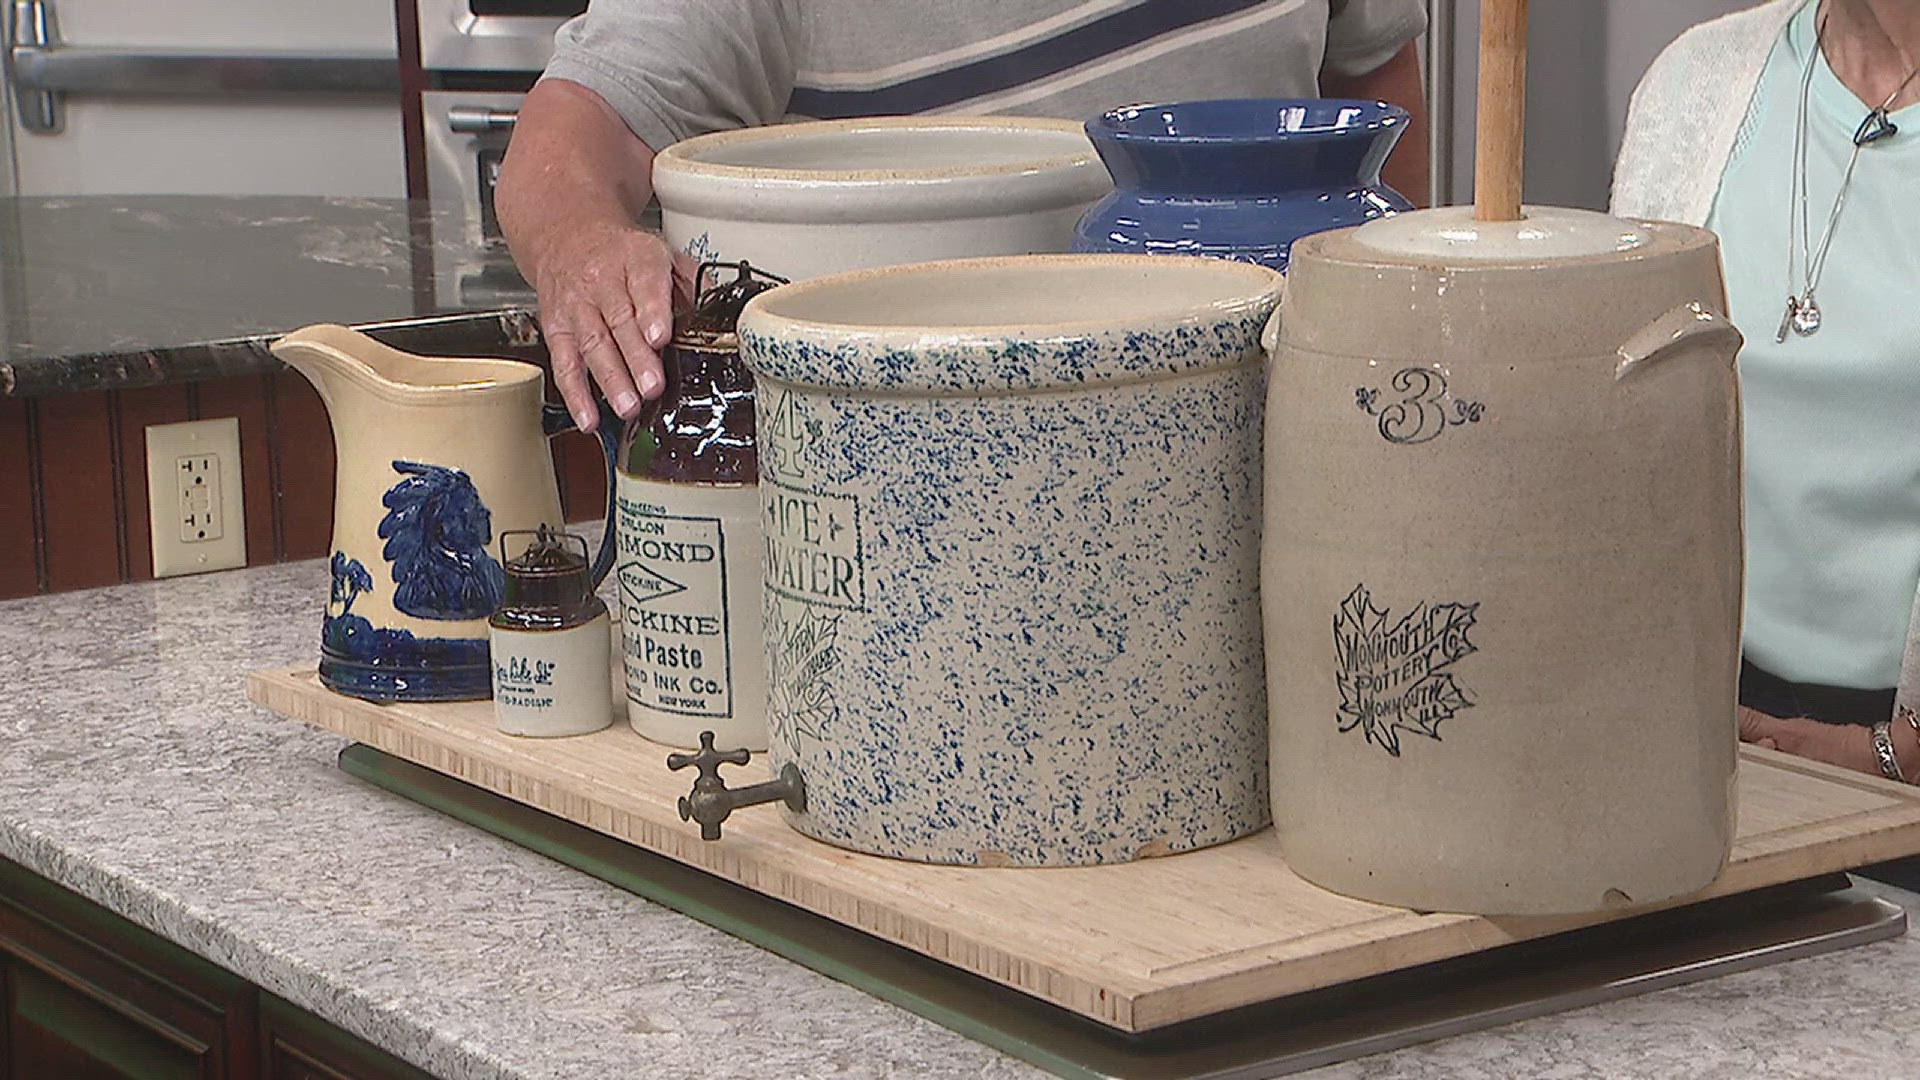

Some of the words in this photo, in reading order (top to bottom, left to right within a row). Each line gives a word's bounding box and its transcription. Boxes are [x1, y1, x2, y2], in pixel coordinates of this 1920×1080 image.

[769, 389, 804, 479] 4
[1378, 368, 1447, 444] 3
[778, 494, 822, 546] ICE
[765, 536, 856, 604] WATER
[645, 637, 703, 669] Paste
[653, 671, 681, 692] INK
[1354, 644, 1440, 704] POTTERY
